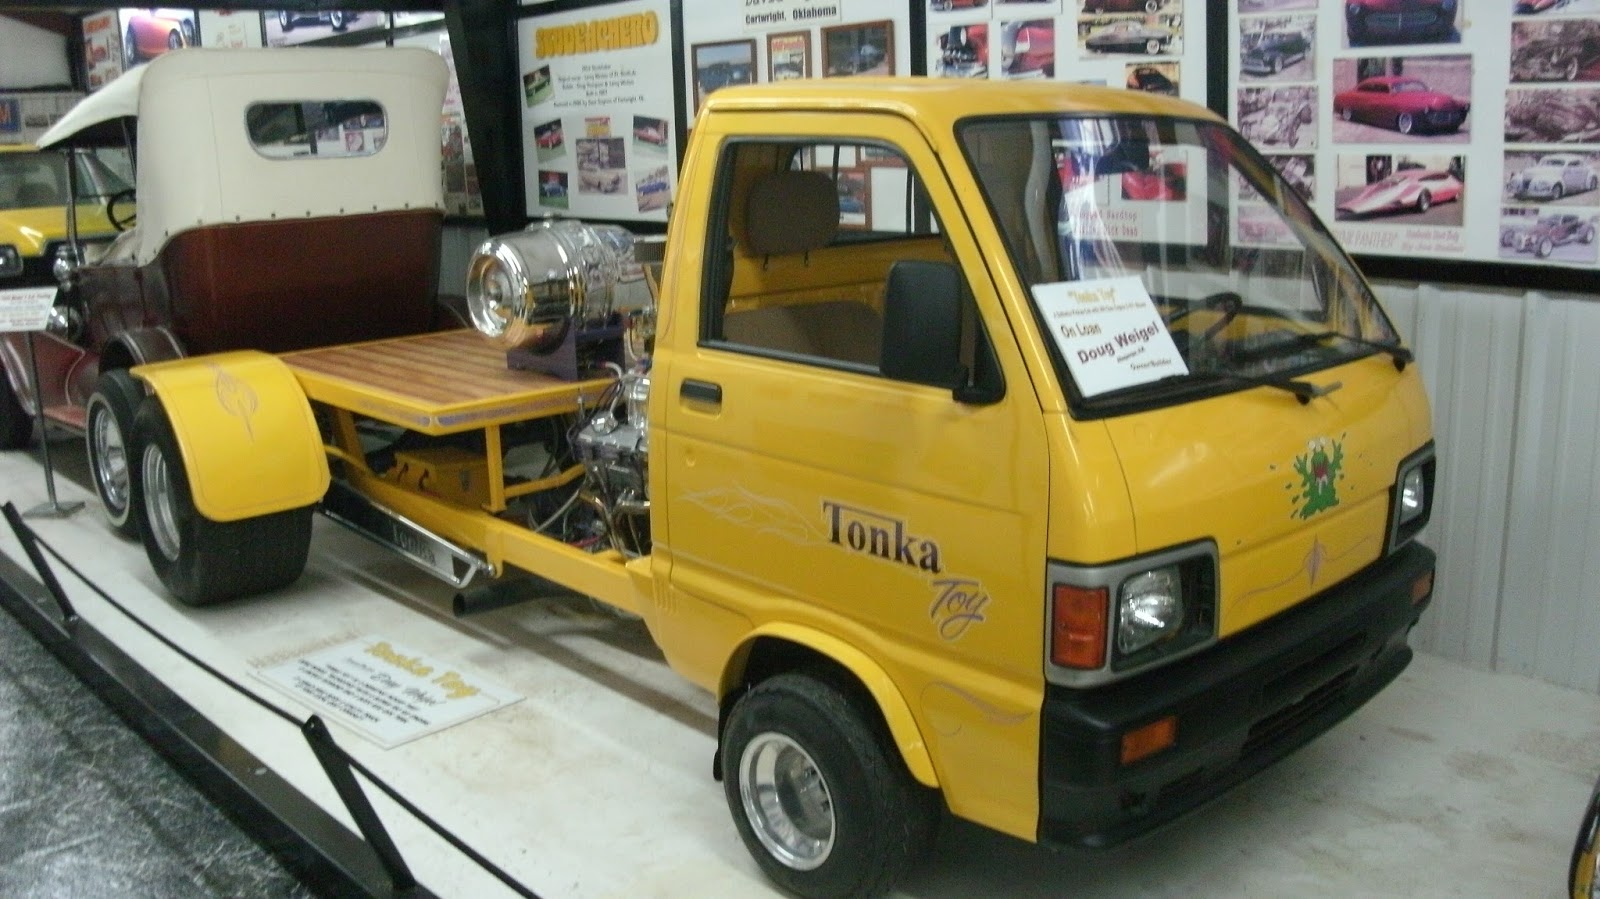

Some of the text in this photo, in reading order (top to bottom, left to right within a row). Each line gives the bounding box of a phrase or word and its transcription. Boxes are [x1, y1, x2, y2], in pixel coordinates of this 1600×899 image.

[792, 6, 837, 21] Oklahoma
[1060, 322, 1102, 338] On Loan
[1077, 341, 1116, 365] Doug
[1114, 321, 1160, 348] Weigel
[821, 500, 942, 575] Tonka
[929, 578, 991, 641] Toy
